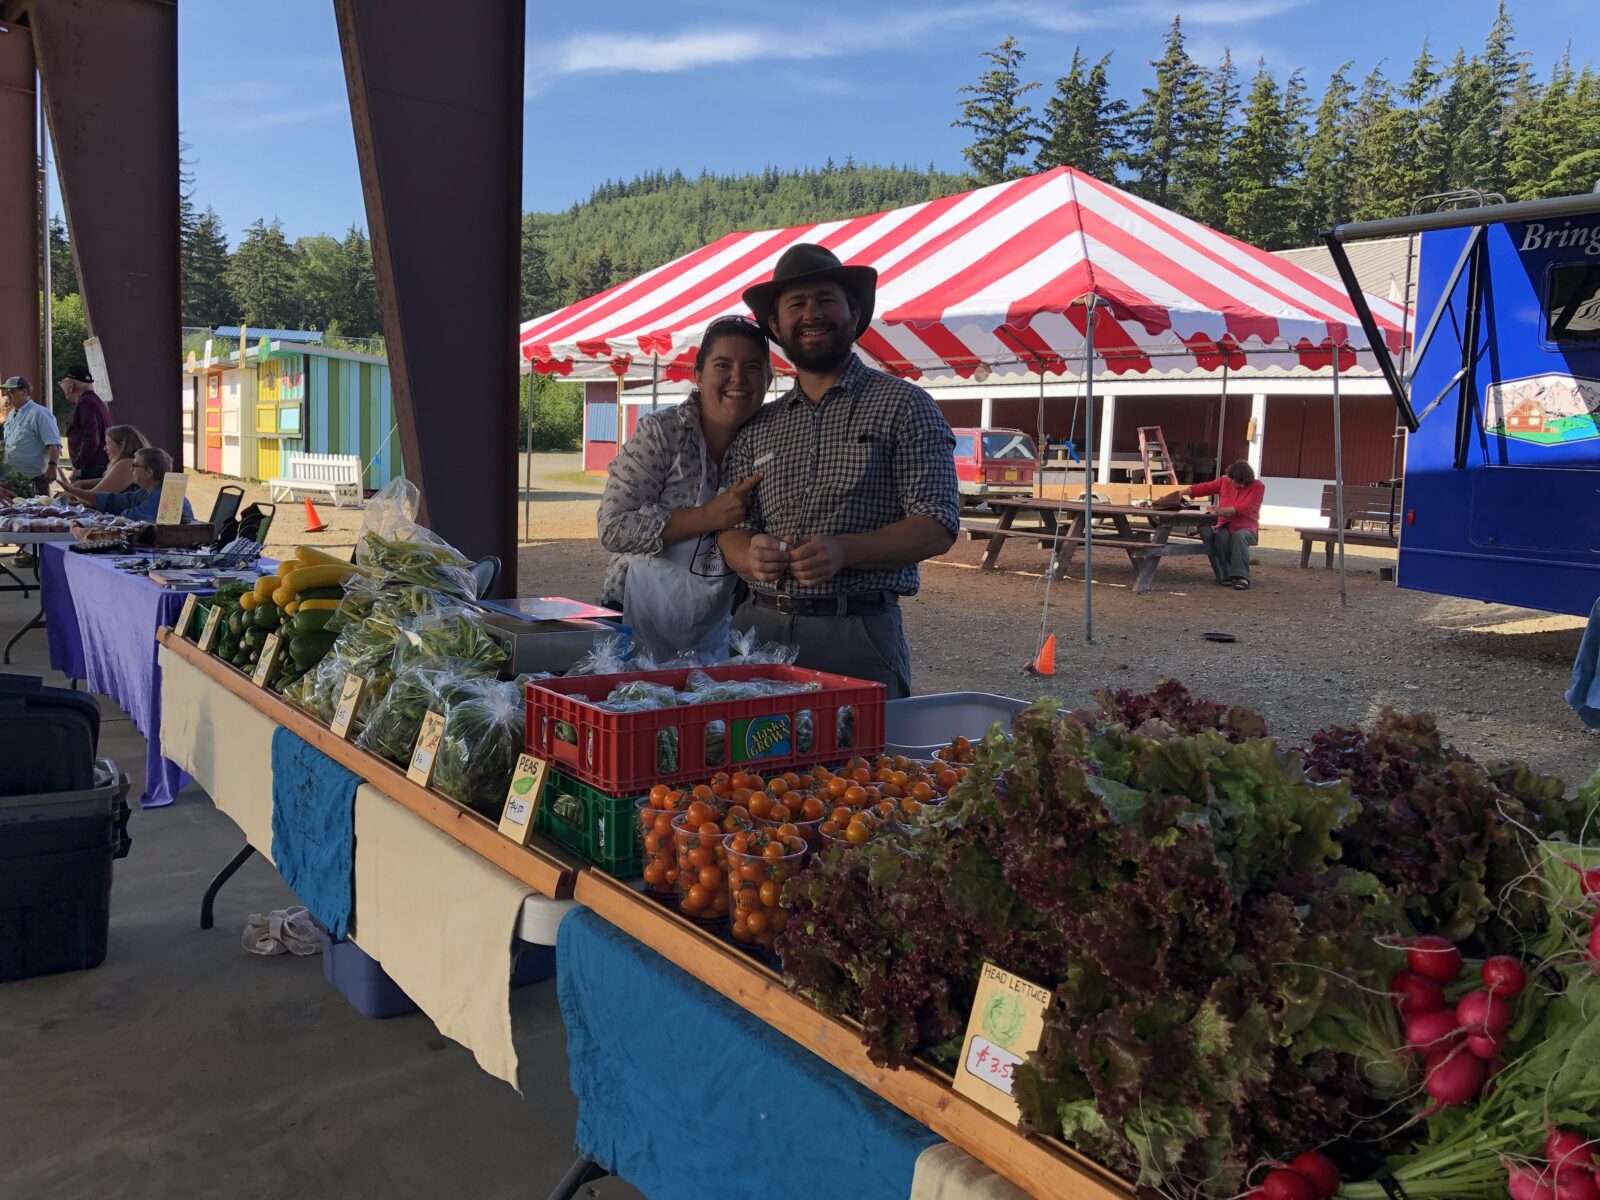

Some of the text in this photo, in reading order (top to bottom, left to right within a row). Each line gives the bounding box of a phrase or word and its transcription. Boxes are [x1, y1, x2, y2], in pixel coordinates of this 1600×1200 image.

[752, 719, 786, 743] Alaska
[518, 756, 539, 775] PEAS
[984, 964, 1048, 1004] HEAD LETTUCE
[976, 1045, 1012, 1078] $3.5
